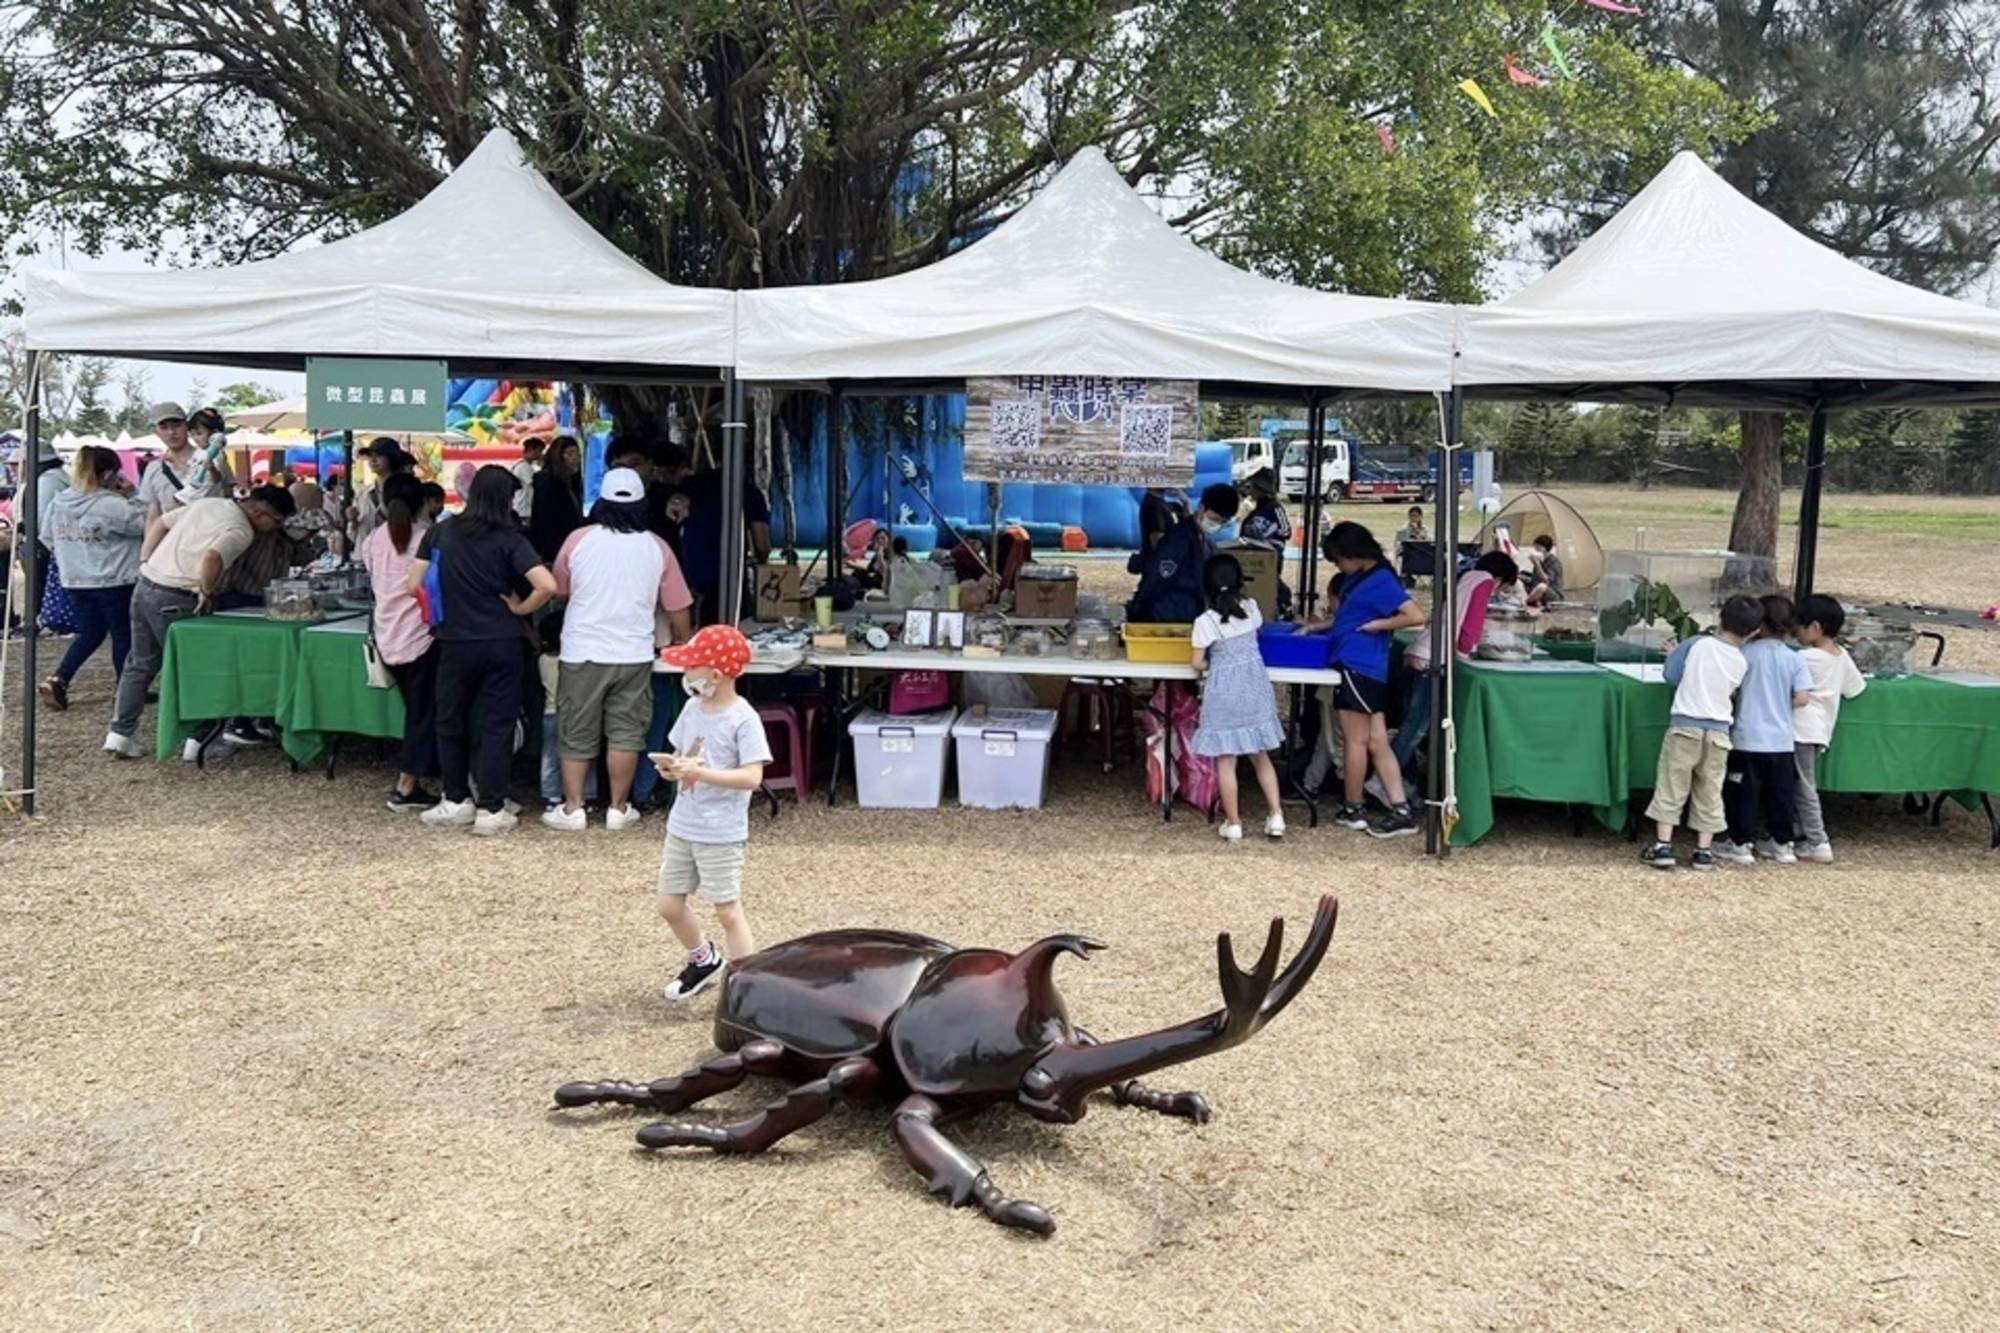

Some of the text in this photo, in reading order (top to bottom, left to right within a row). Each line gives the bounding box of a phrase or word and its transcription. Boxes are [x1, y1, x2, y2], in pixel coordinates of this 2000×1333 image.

[326, 385, 427, 405] 微型昆蟲展
